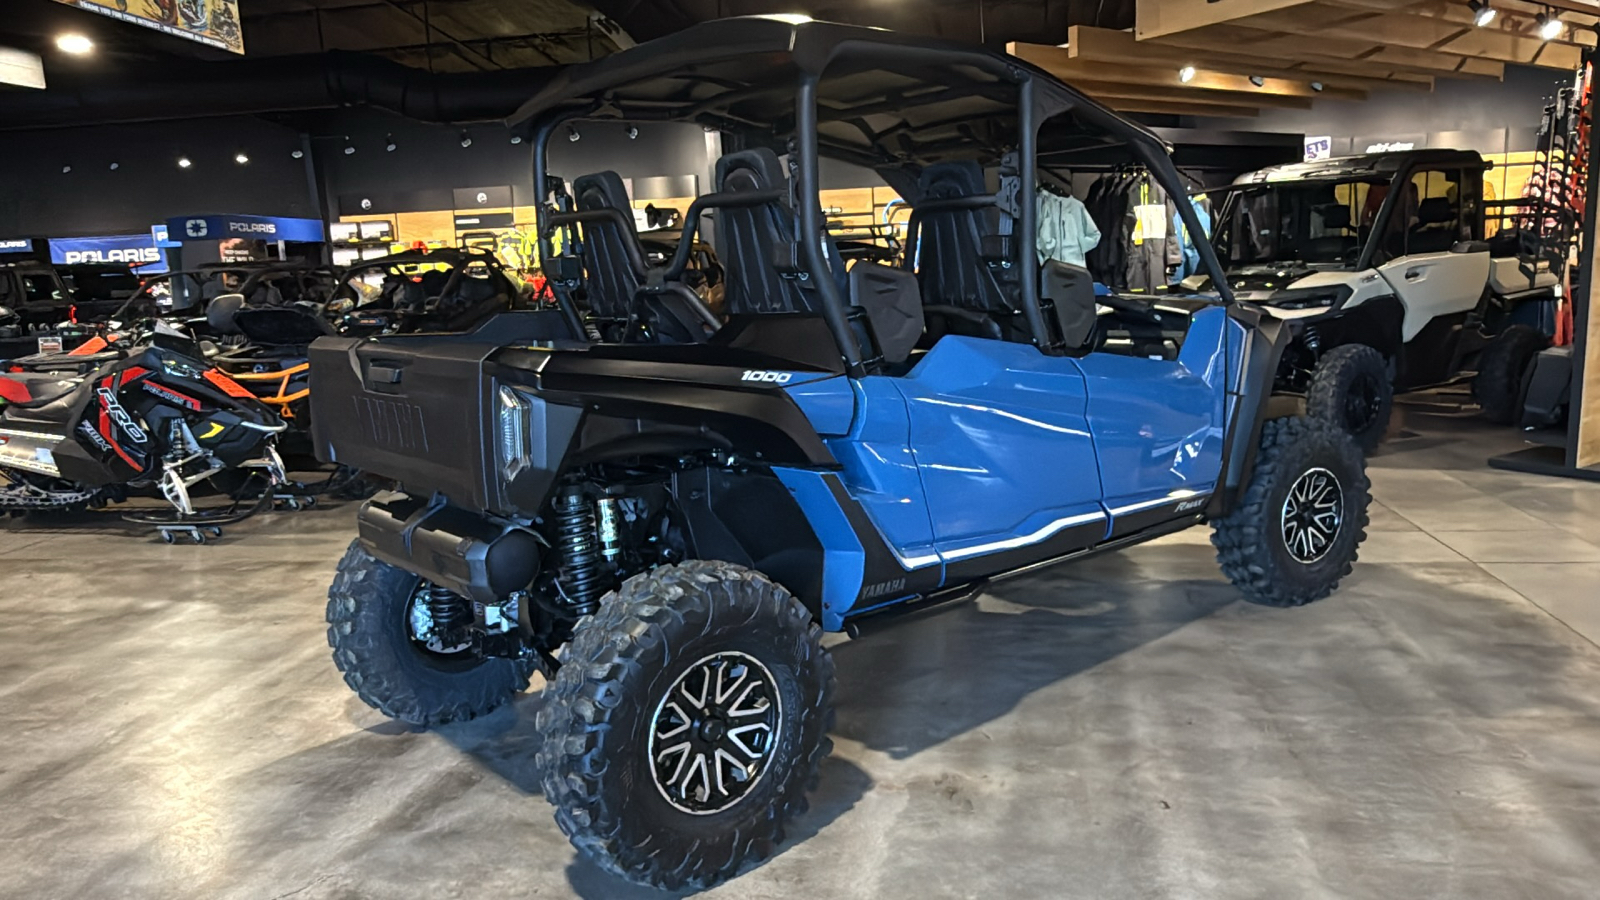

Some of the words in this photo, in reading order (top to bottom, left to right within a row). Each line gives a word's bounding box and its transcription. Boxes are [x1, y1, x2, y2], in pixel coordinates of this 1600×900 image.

[229, 222, 276, 234] POLARIS
[66, 247, 160, 264] POLARIS
[741, 370, 792, 383] 1000
[97, 387, 148, 443] PRO
[861, 577, 906, 600] YAMAHA
